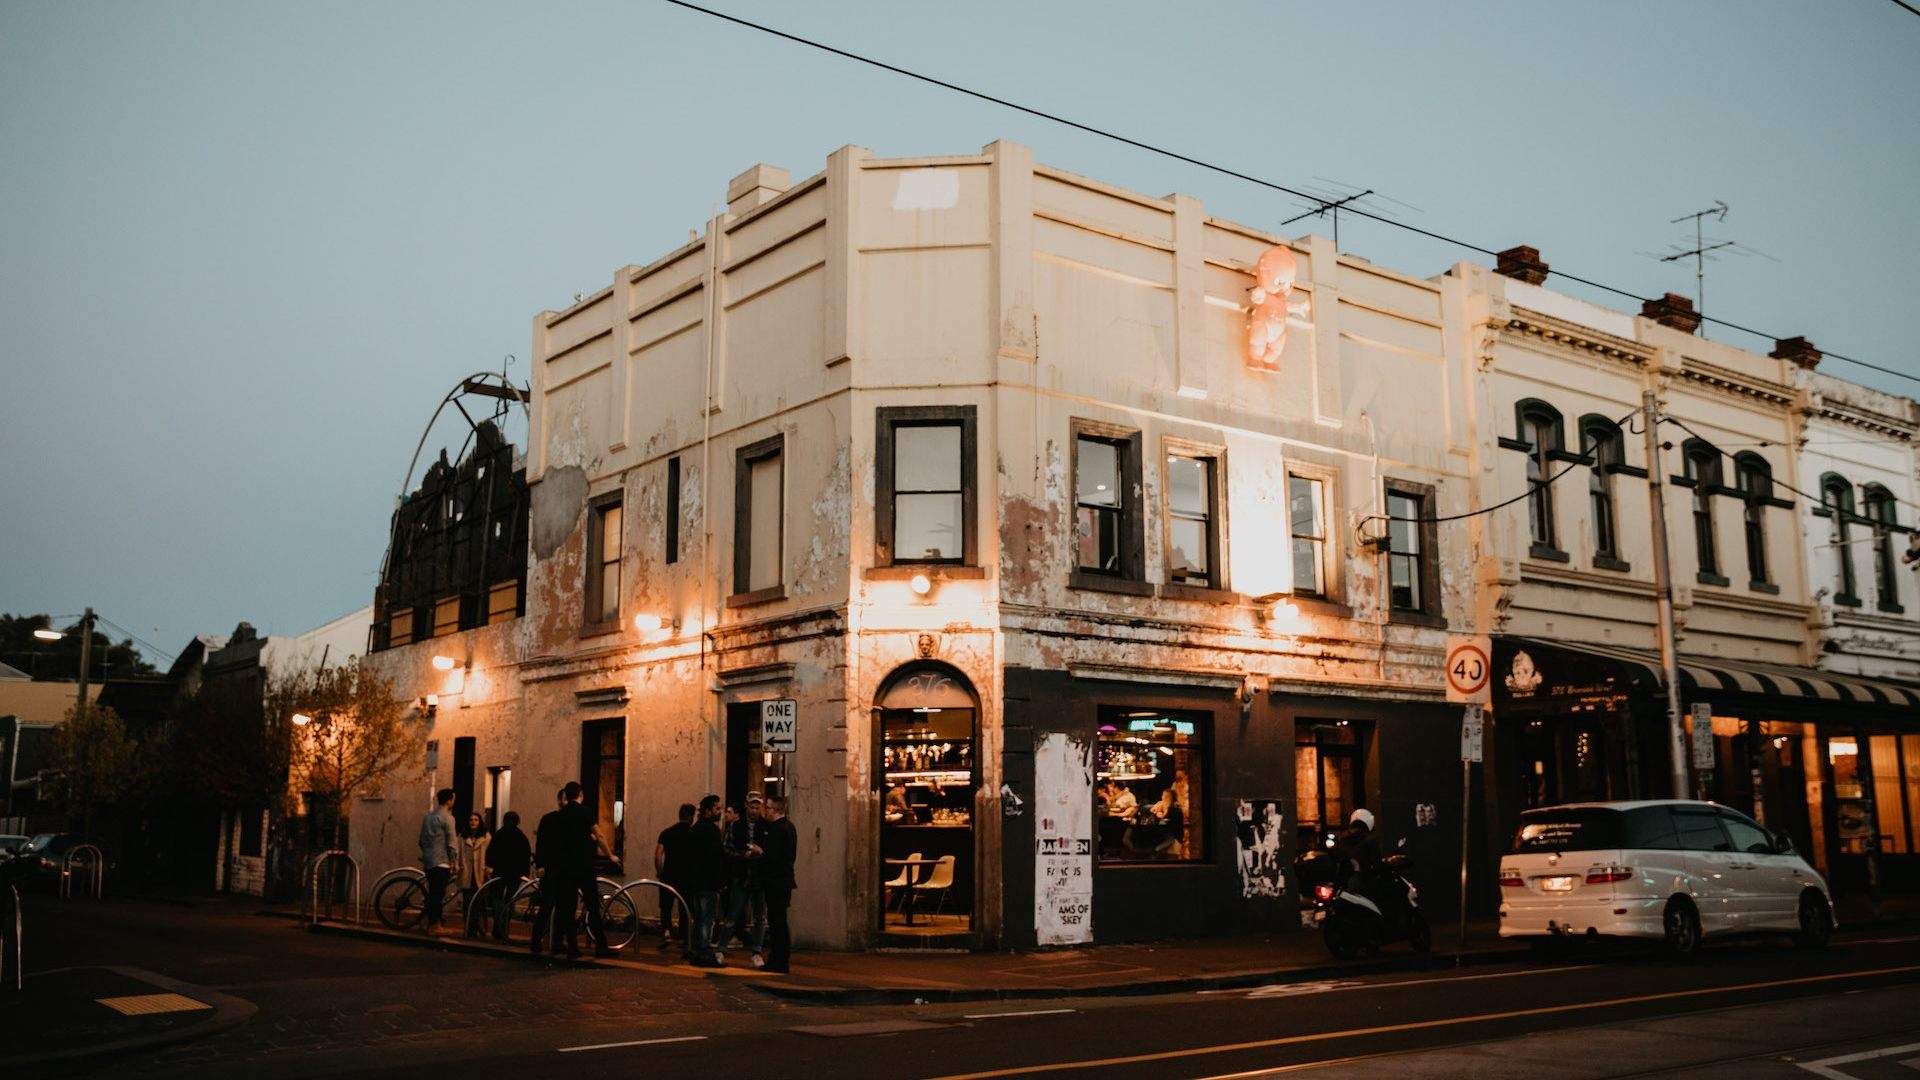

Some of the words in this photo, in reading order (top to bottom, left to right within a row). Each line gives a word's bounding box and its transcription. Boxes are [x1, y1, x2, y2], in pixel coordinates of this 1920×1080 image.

[1453, 659, 1482, 680] 40
[766, 704, 791, 717] ONE
[765, 721, 793, 733] WAY
[1078, 904, 1089, 914] OF
